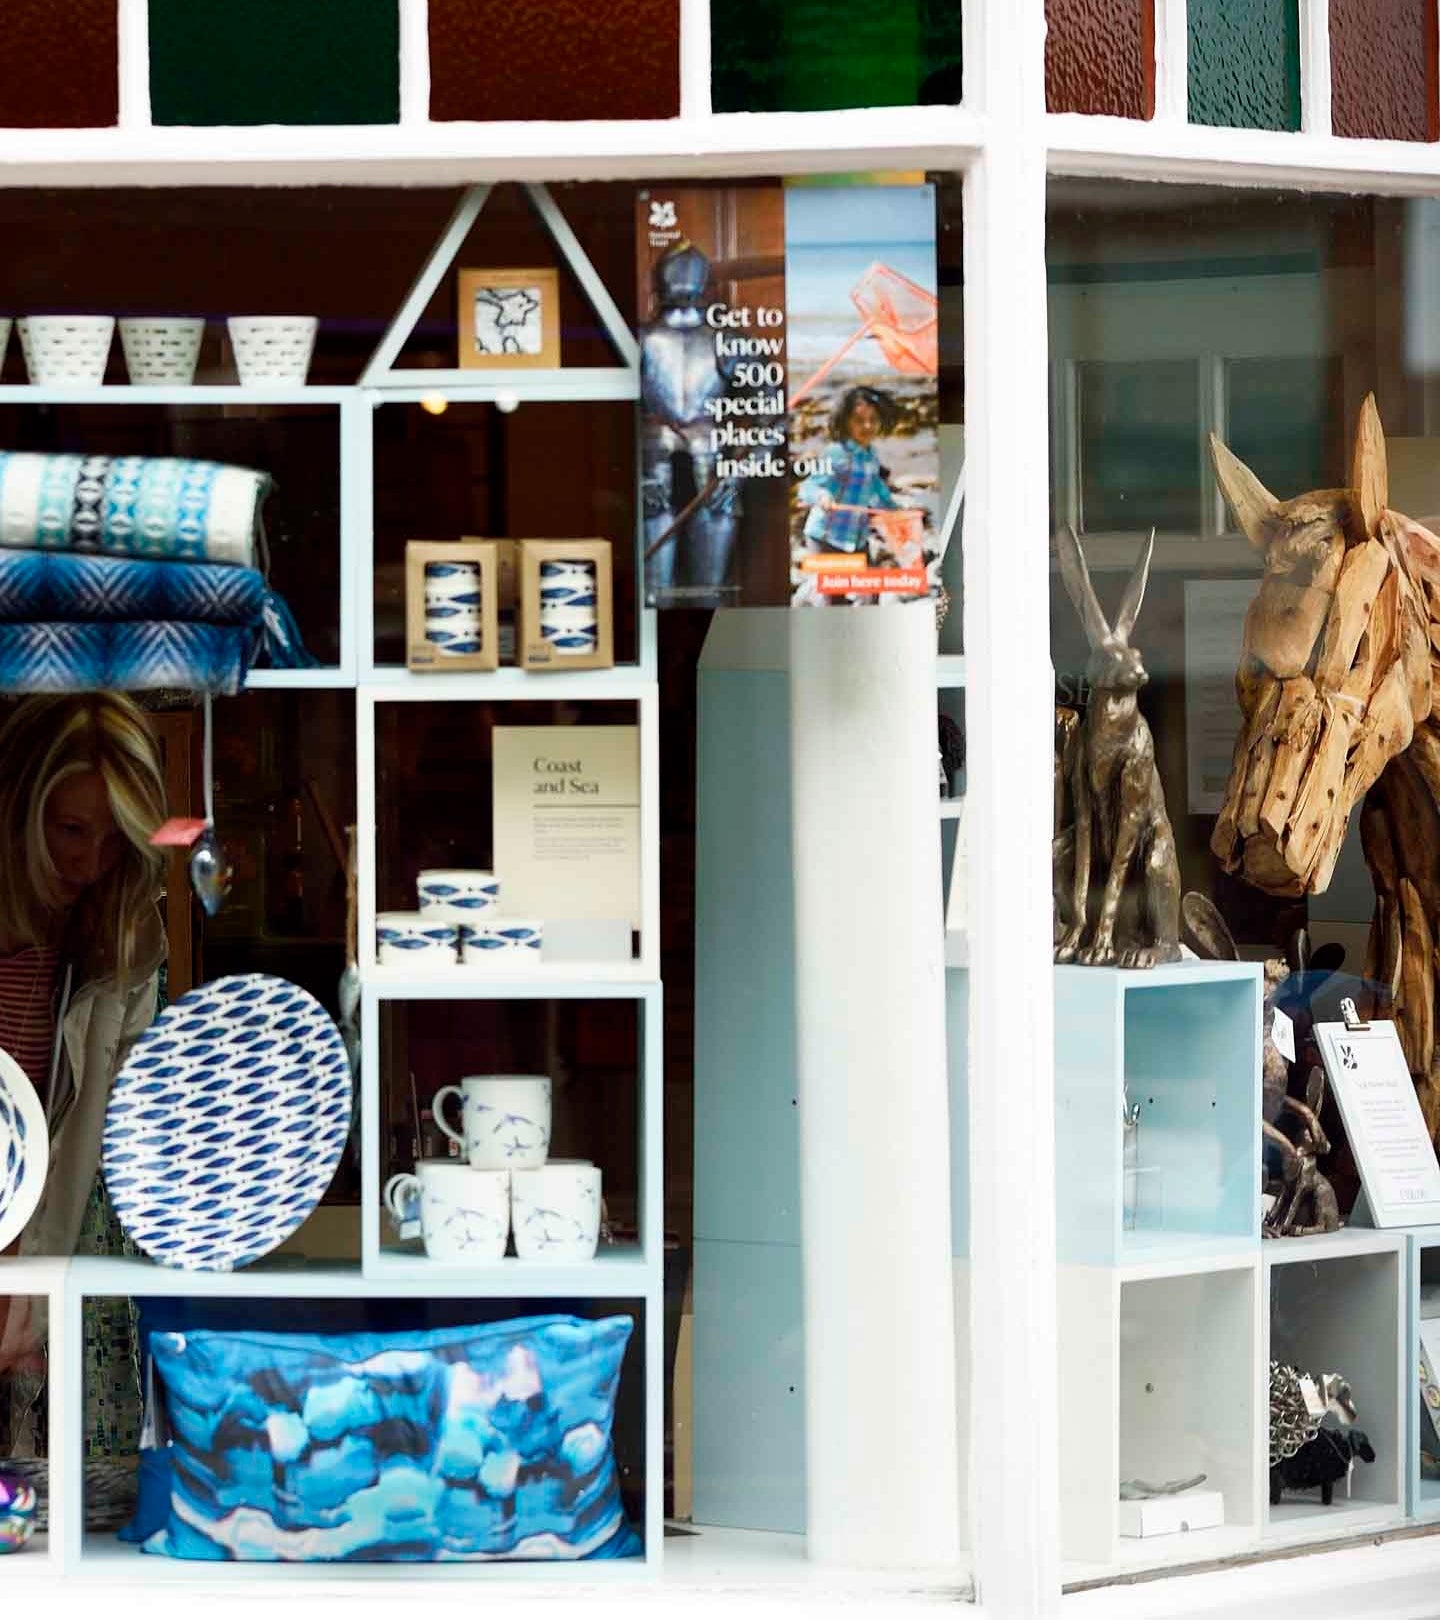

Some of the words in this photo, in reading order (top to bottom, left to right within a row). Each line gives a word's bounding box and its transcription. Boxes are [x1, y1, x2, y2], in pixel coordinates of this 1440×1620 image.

[706, 303, 751, 328] Get
[756, 306, 784, 328] to
[715, 331, 785, 357] know
[731, 362, 785, 388] 500
[703, 389, 785, 423] special
[711, 421, 786, 453] places
[715, 451, 786, 478] inside
[792, 456, 835, 477] out
[822, 574, 850, 588] Join
[851, 573, 882, 588] here
[883, 572, 921, 591] today
[533, 756, 583, 774] Coast
[532, 777, 565, 795] and
[568, 778, 600, 795] Sea
